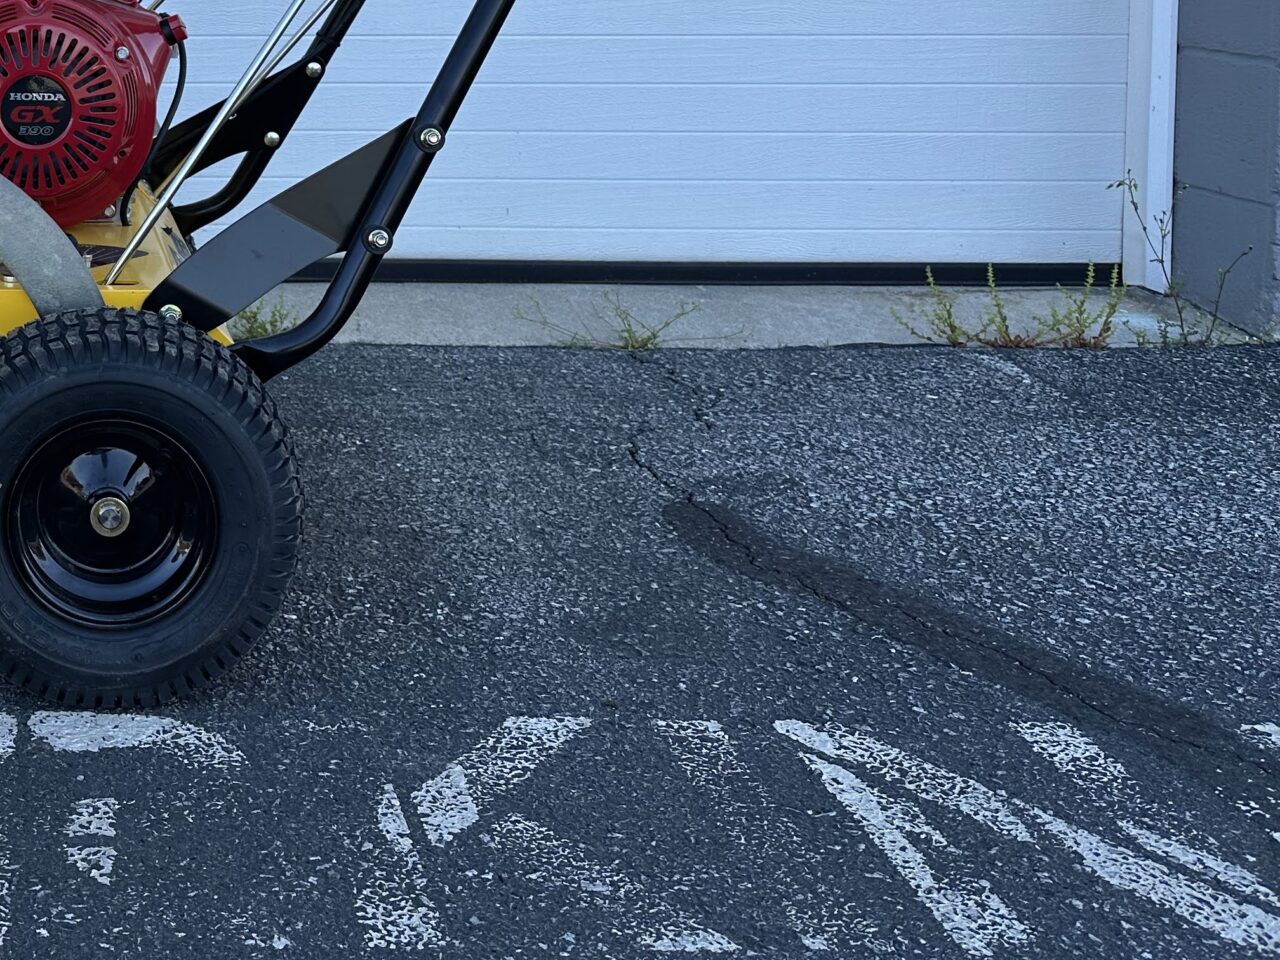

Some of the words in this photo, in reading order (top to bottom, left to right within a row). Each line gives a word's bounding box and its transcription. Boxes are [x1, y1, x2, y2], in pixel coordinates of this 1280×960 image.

[9, 92, 66, 101] HONDA
[10, 104, 64, 123] GX
[18, 126, 54, 136] 390
